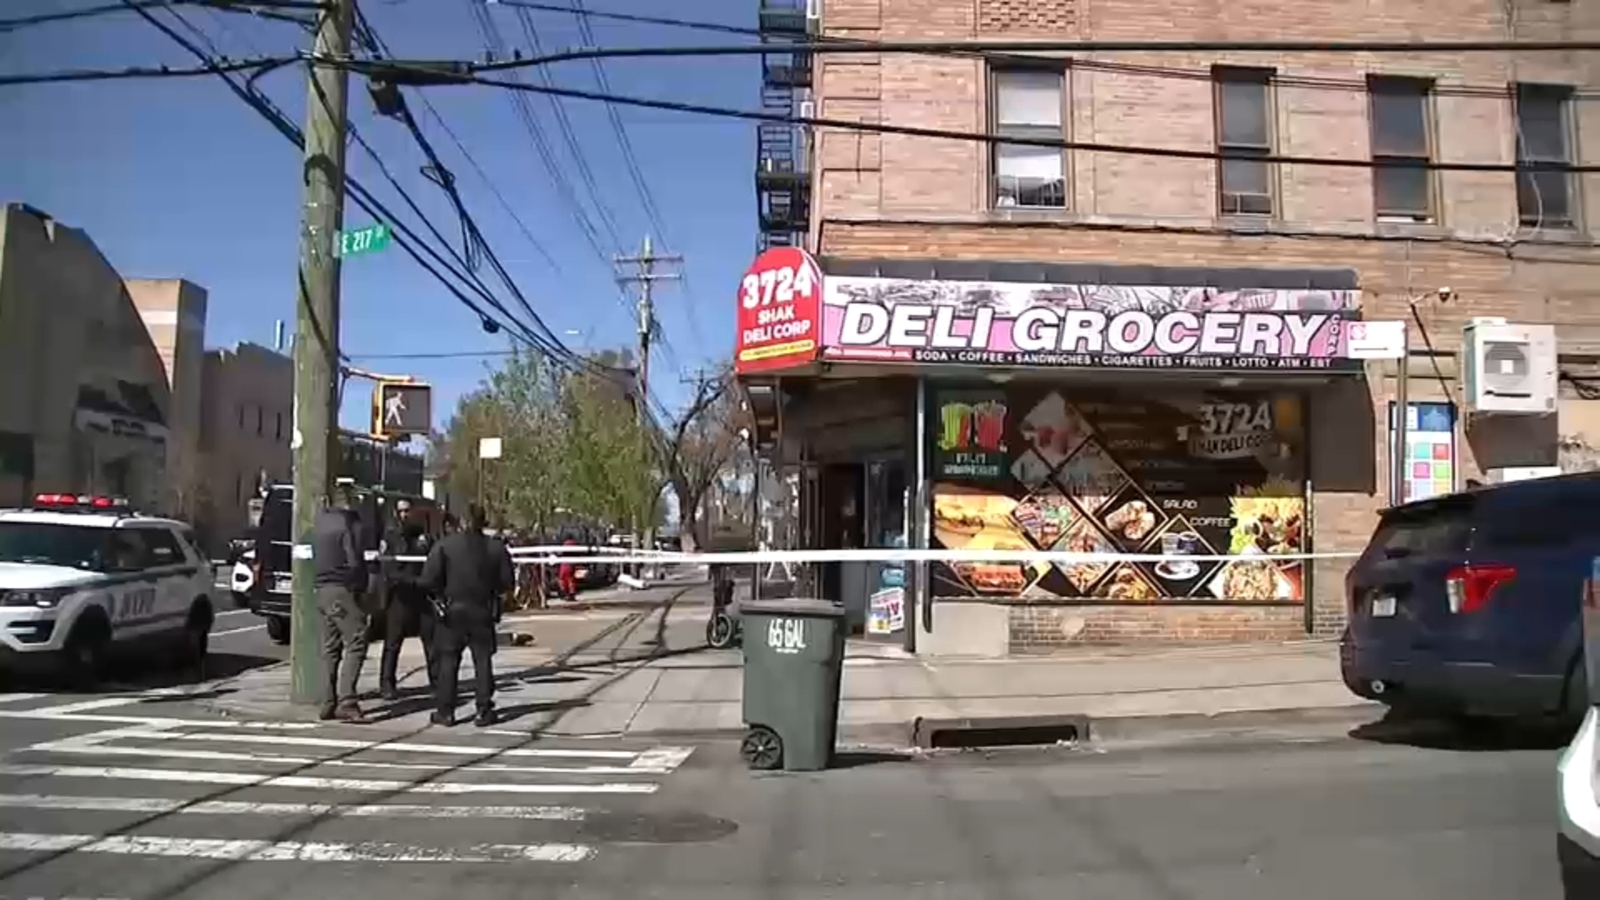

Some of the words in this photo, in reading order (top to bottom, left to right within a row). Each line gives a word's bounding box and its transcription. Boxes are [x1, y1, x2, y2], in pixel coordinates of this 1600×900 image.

[342, 233, 349, 254] E
[353, 229, 373, 252] 217
[743, 260, 813, 309] 3724
[758, 305, 795, 325] SHAK
[743, 326, 772, 344] DELI
[773, 319, 812, 339] CORP
[840, 303, 995, 349] DELI
[1011, 306, 1328, 356] GROCERY
[914, 350, 948, 361] SODA
[958, 351, 1004, 363] COFFEE
[1015, 352, 1092, 366] SANDWICHES
[1101, 355, 1172, 367] CIGARETTES
[1183, 355, 1222, 368] FRUITS
[1231, 357, 1269, 368] LOTTO
[1277, 358, 1301, 369] ATM
[1200, 401, 1271, 433] 3724
[1163, 499, 1198, 509] SALAD
[1189, 516, 1231, 528] COFFEE
[768, 618, 783, 648] 65
[784, 618, 807, 648] GAL
